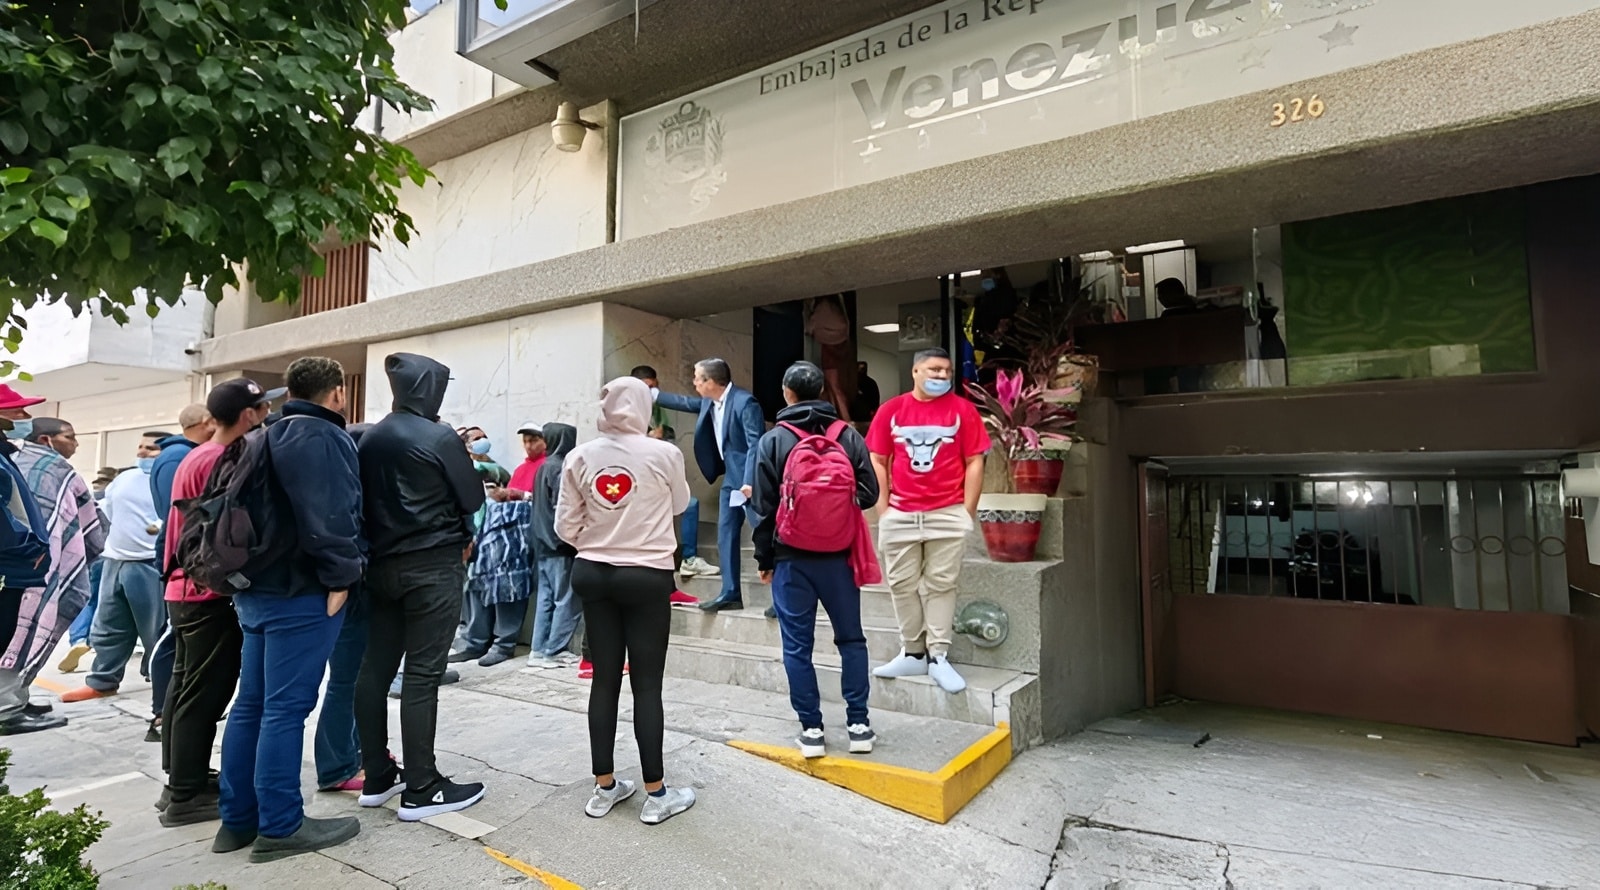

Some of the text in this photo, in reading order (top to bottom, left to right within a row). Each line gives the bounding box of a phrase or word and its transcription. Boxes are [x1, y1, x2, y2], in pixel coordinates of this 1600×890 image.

[760, 38, 887, 95] Embajada
[897, 21, 932, 48] de
[943, 9, 969, 34] la
[1270, 94, 1325, 128] 326
